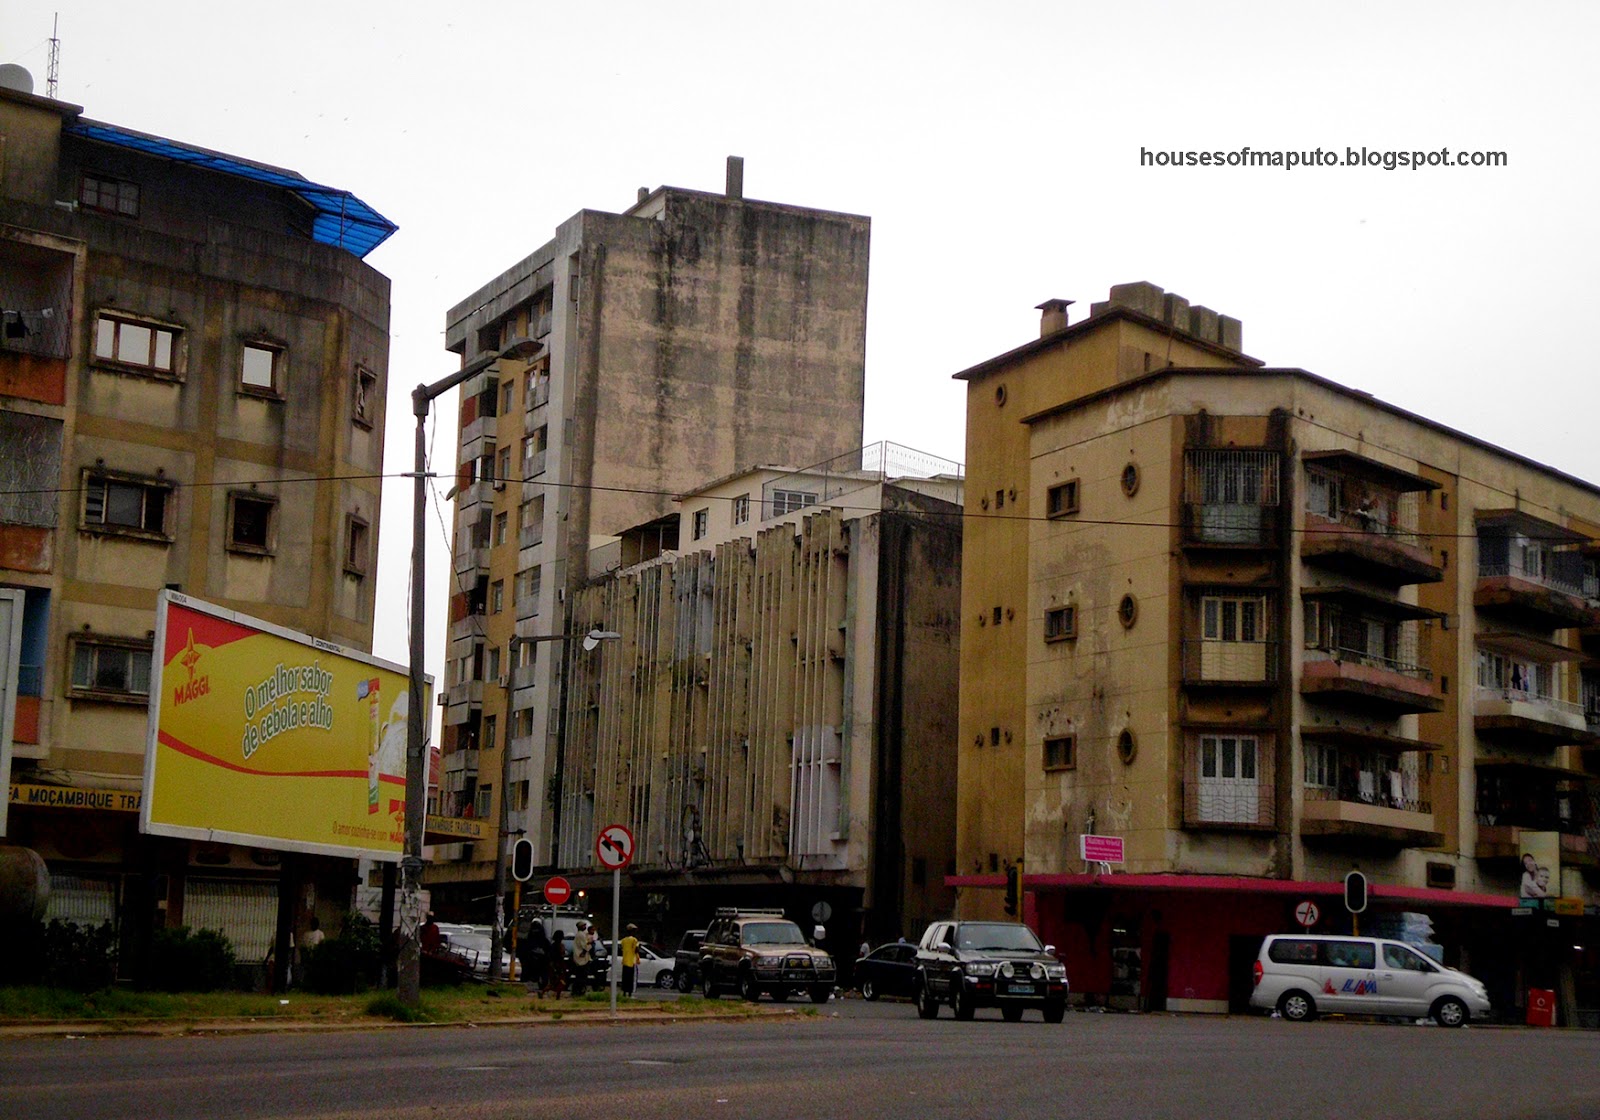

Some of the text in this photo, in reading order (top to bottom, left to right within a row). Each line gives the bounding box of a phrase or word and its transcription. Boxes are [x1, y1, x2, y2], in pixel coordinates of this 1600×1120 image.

[174, 674, 209, 707] MAGGI
[245, 659, 333, 720] O melhor sabor
[242, 693, 333, 760] de cebola e alho
[29, 788, 113, 808] MOÇAMBIQUE
[332, 820, 338, 835] O
[338, 824, 351, 836] amor
